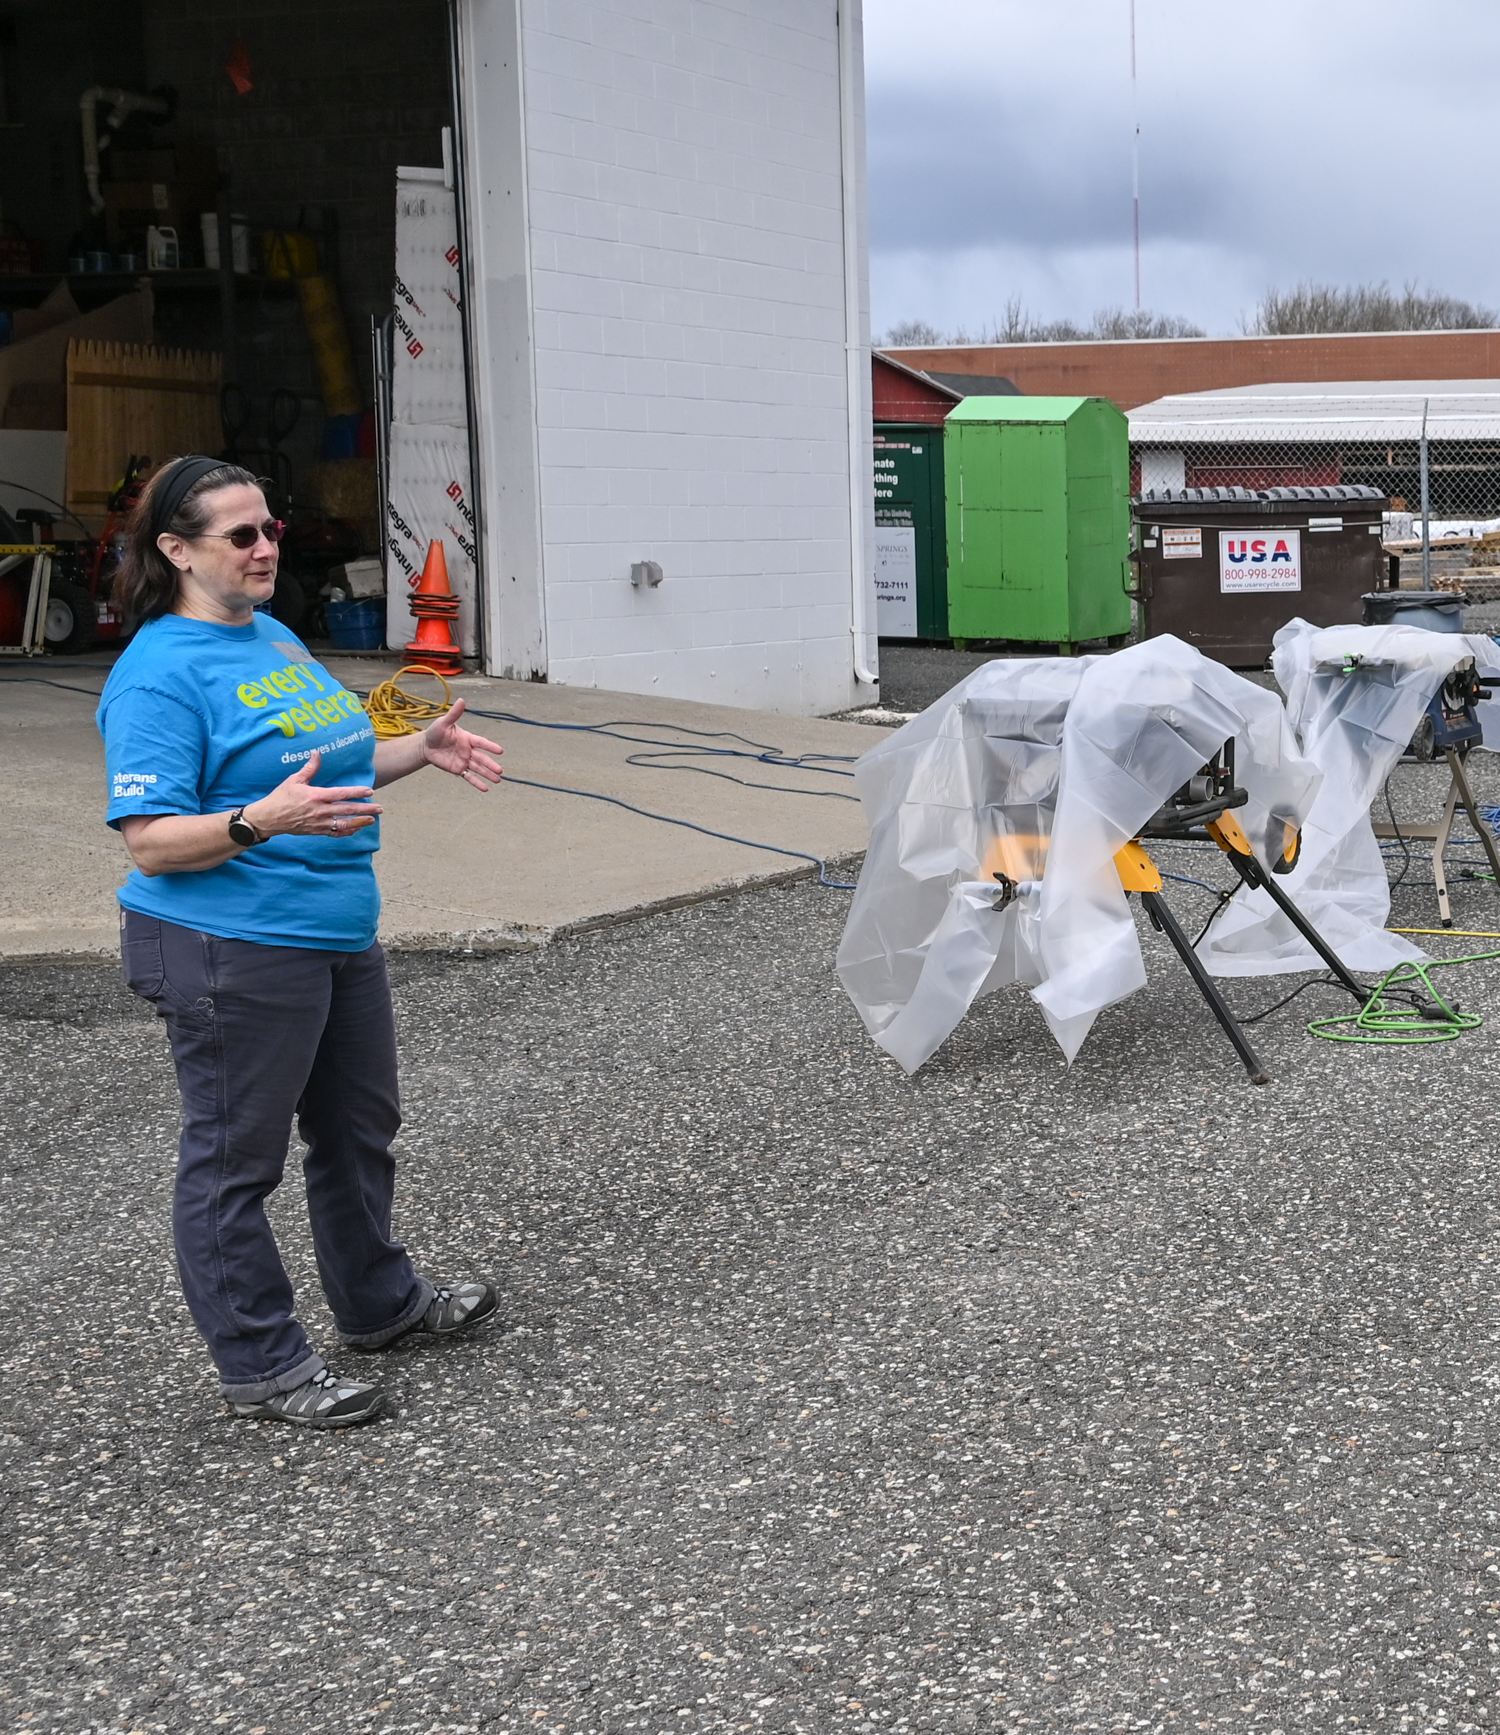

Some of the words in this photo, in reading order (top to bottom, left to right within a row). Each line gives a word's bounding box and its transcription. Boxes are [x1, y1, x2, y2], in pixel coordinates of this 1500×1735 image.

[874, 458, 895, 468] nate
[875, 473, 898, 485] thing
[1228, 539, 1292, 564] USA
[1225, 568, 1297, 580] 800-998-2984
[876, 581, 909, 589] 732-7111
[1226, 580, 1297, 589] www.usarecycle.com
[237, 664, 325, 709] every
[267, 690, 363, 737] vetera
[330, 741, 337, 752] a
[336, 731, 360, 749] decent
[359, 727, 375, 742] plac
[114, 783, 145, 798] Build
